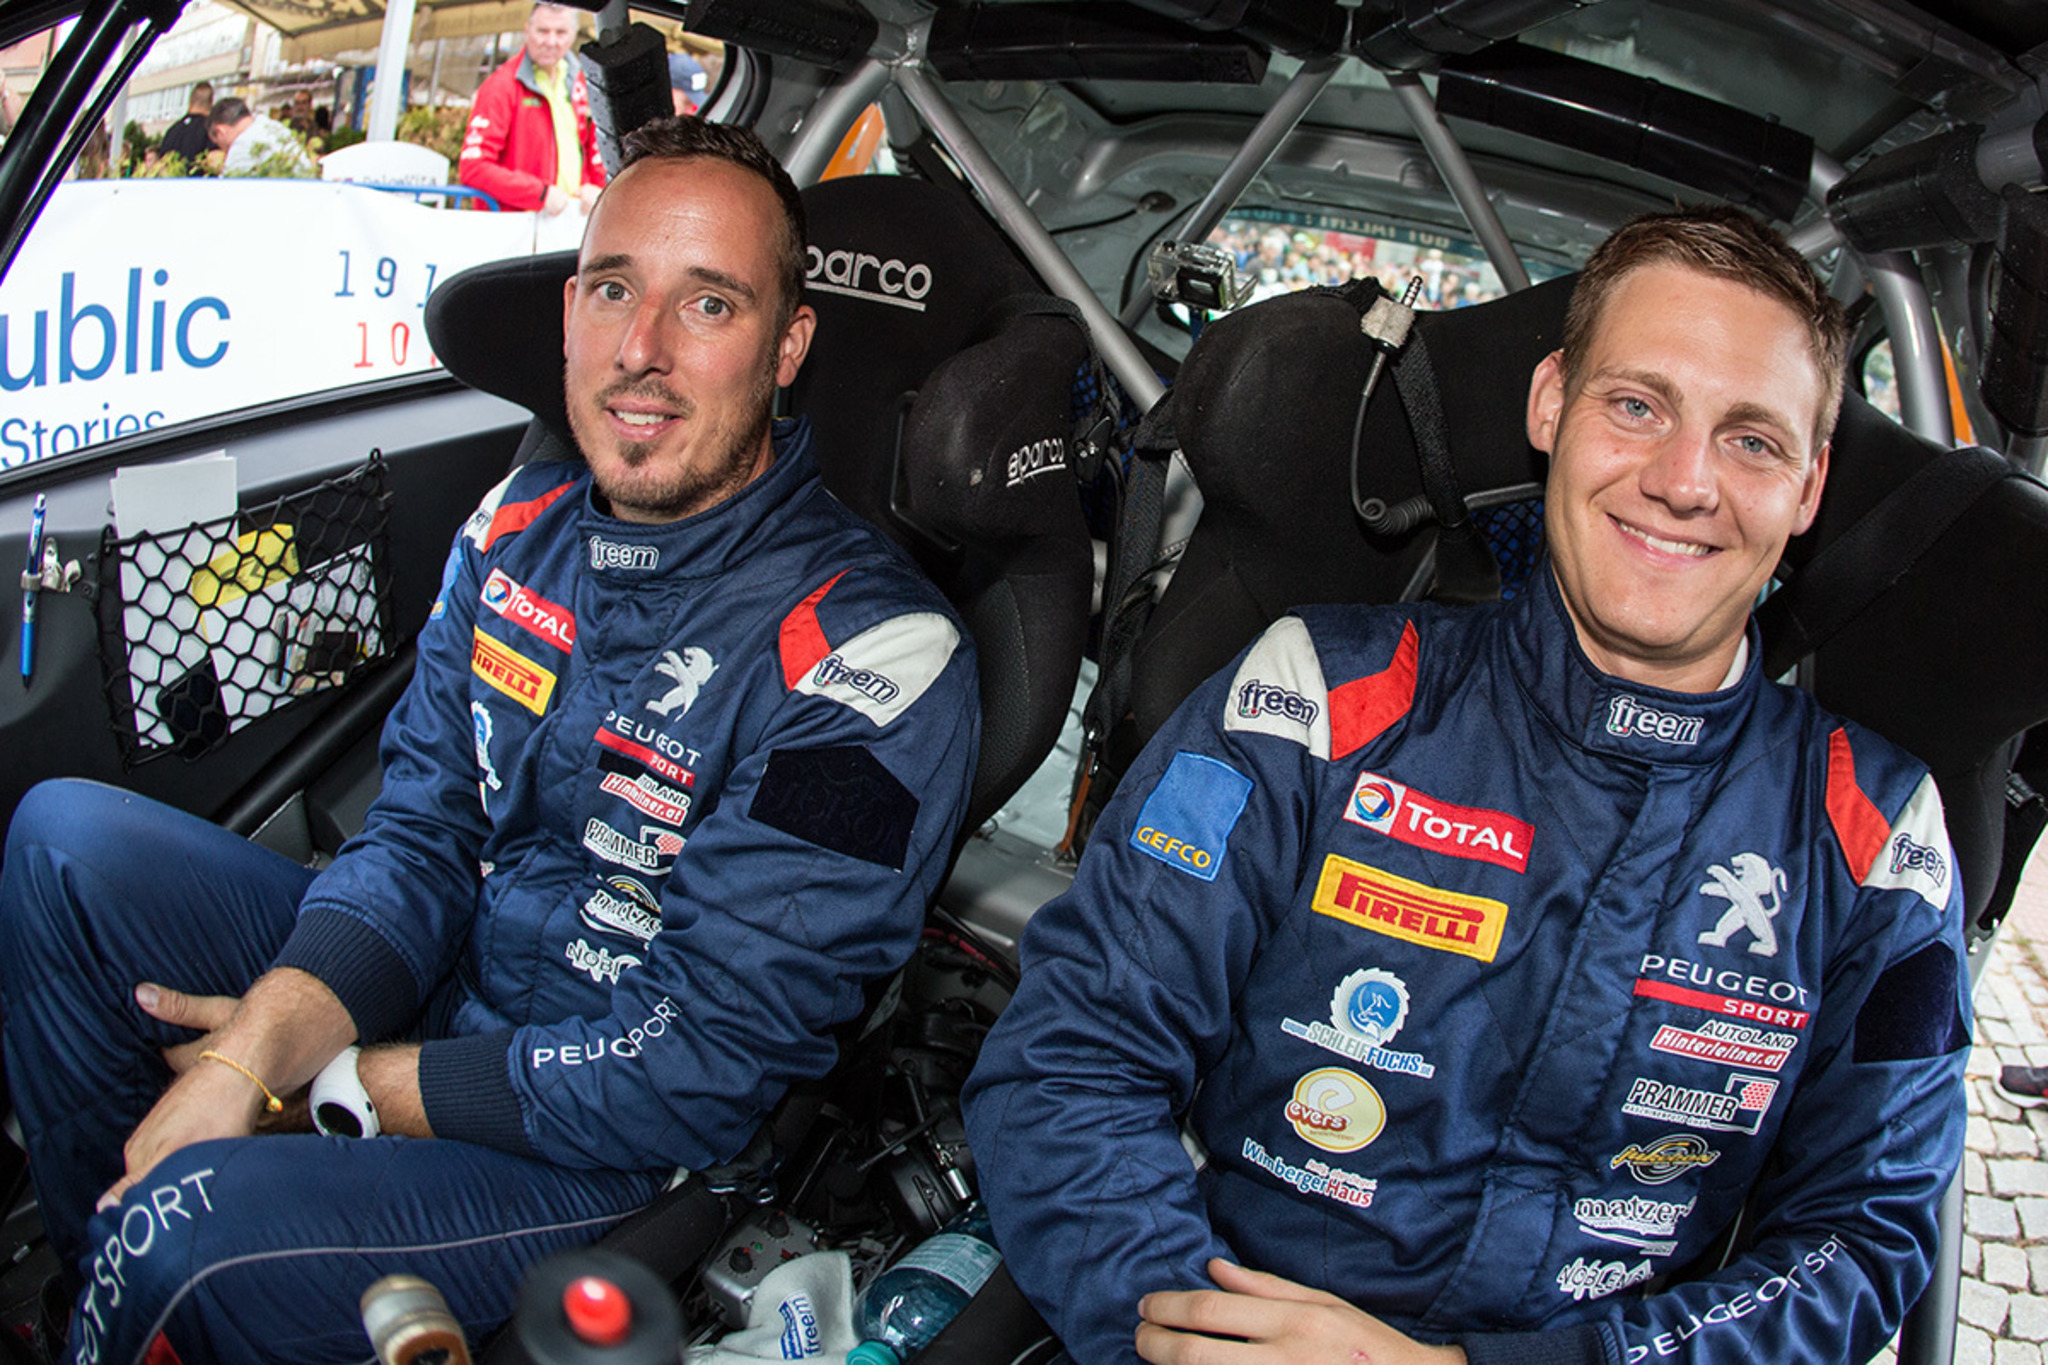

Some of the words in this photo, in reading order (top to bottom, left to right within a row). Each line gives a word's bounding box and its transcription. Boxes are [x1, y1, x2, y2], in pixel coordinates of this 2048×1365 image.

[806, 245, 932, 300] parco
[1, 402, 165, 467] Stories
[590, 537, 658, 568] freem
[511, 593, 573, 645] TOTAL
[472, 639, 542, 701] PIRELLI
[815, 654, 899, 703] freem
[1607, 696, 1704, 746] freem
[650, 754, 692, 785] PORT
[1137, 826, 1212, 869] GEFCO
[1406, 801, 1524, 860] TOTAL
[1334, 872, 1485, 945] PIRELLI
[1640, 954, 1808, 1006] PEUGEOT
[628, 996, 683, 1052] PORT
[1701, 1022, 1796, 1049] AUTOLAND
[1723, 999, 1808, 1025] SPORT
[1629, 1080, 1738, 1121] PRAMMER
[1575, 1196, 1689, 1224] matzer
[94, 1168, 215, 1308] SPORT
